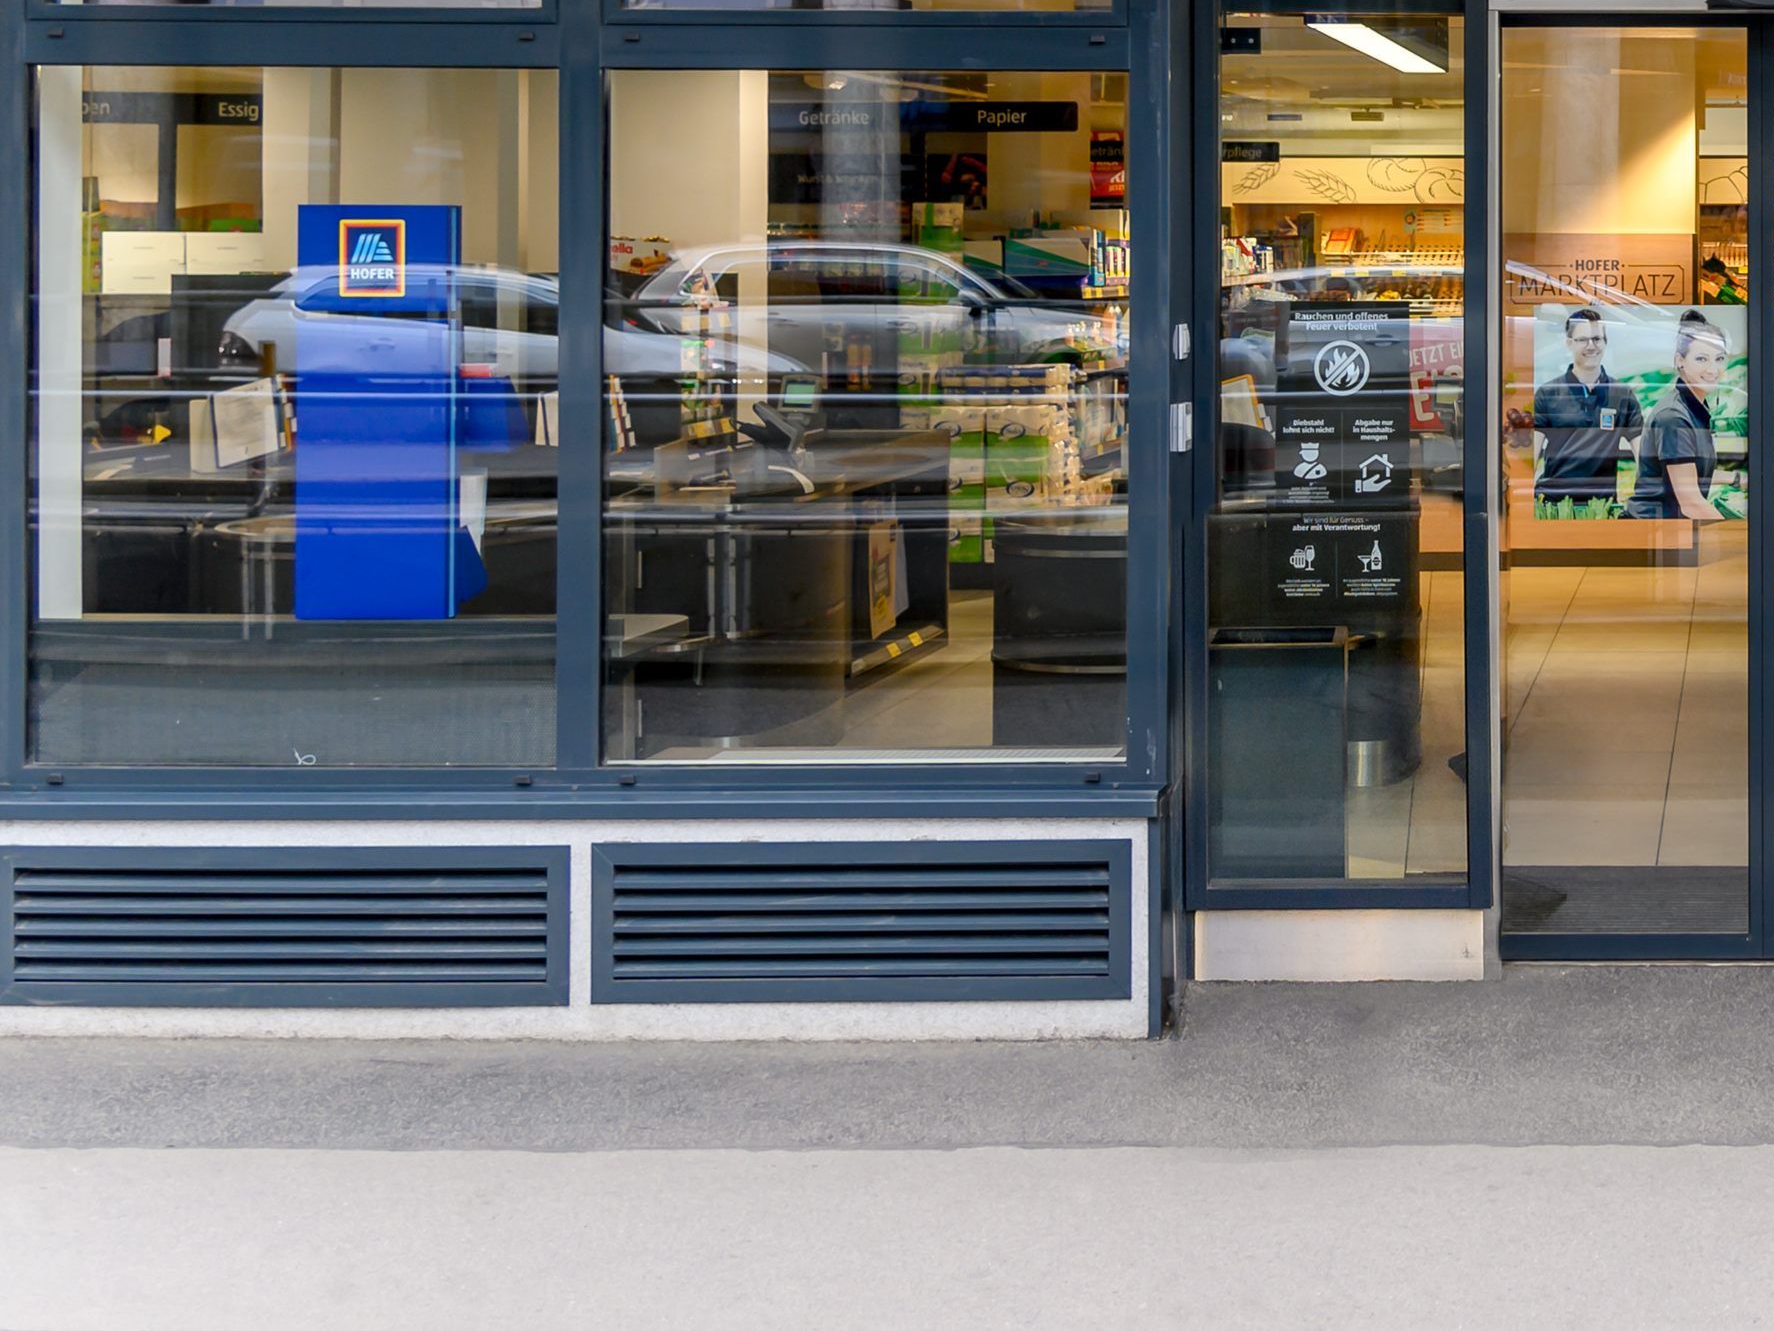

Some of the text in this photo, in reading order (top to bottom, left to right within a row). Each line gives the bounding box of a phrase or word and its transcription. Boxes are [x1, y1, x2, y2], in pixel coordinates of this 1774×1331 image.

[218, 101, 259, 121] Essig
[798, 110, 870, 125] Getränke
[977, 108, 1027, 127] Papier
[1575, 259, 1620, 271] HOFER
[350, 267, 395, 280] HOFER
[1519, 273, 1676, 297] MARKTPLATZ
[1294, 312, 1389, 321] Rauchen und offenes
[1305, 322, 1333, 331] Feuer
[1409, 344, 1445, 367] JETZT
[1354, 419, 1381, 427] Abgabe
[1360, 434, 1388, 442] mengen
[1292, 523, 1381, 533] aber mit Verantwortung!
